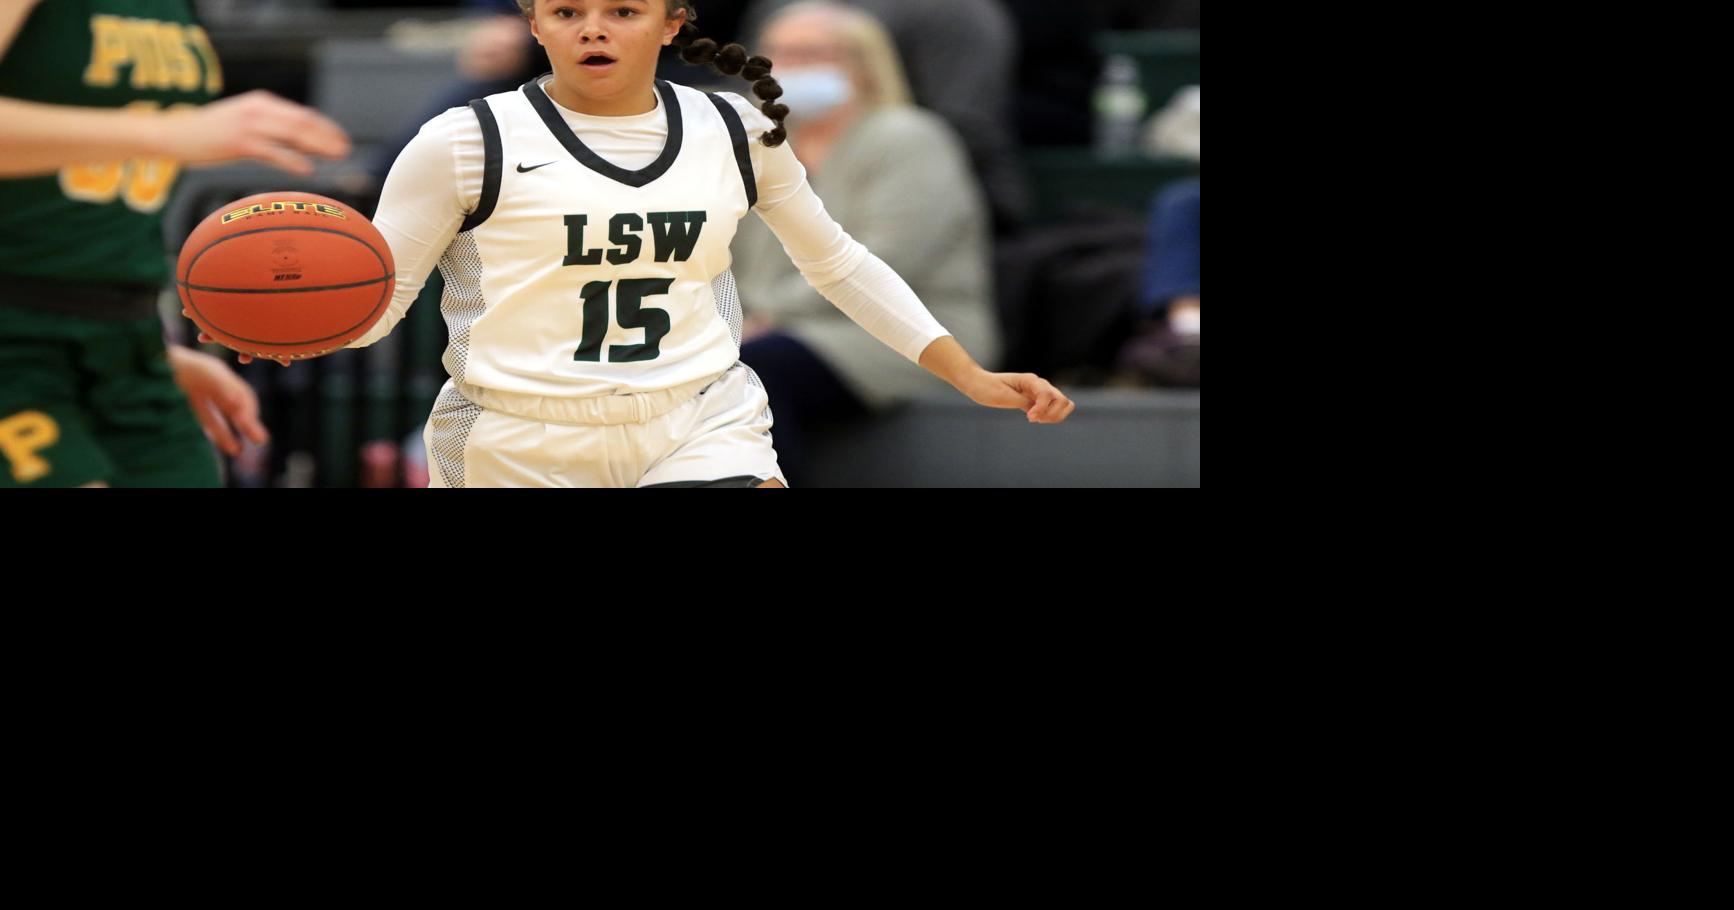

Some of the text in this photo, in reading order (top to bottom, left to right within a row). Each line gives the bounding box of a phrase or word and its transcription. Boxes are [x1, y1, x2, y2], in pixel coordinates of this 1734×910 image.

[221, 201, 347, 225] ELITE
[563, 211, 706, 266] LSW
[574, 278, 676, 362] 15
[0, 410, 59, 482] P
